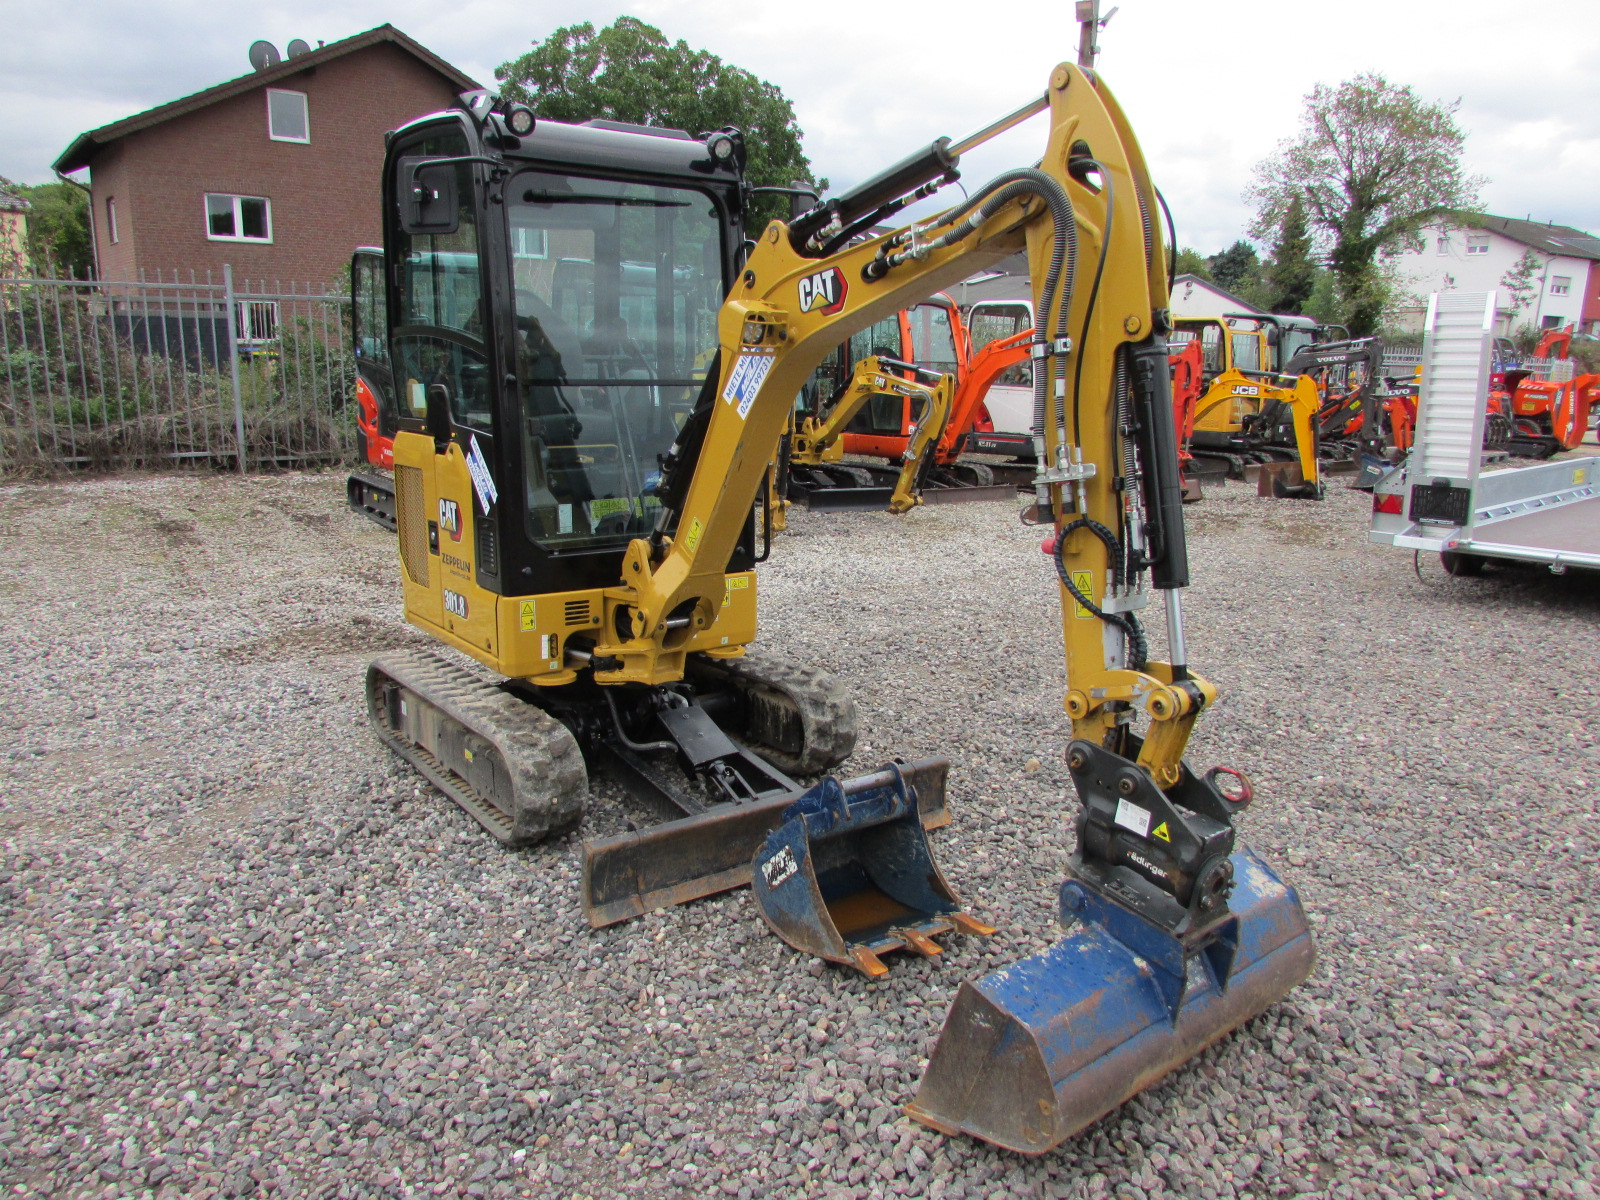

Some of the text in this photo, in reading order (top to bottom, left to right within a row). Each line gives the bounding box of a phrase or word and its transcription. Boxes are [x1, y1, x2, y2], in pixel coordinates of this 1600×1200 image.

[798, 268, 835, 313] CAT
[1315, 355, 1347, 363] VOLVO
[725, 369, 742, 399] MIETE
[1231, 385, 1258, 395] JCB
[1387, 388, 1410, 396] LVO
[439, 498, 457, 532] CAT
[441, 552, 470, 573] ZEPPELIN
[444, 589, 465, 617] 301.8
